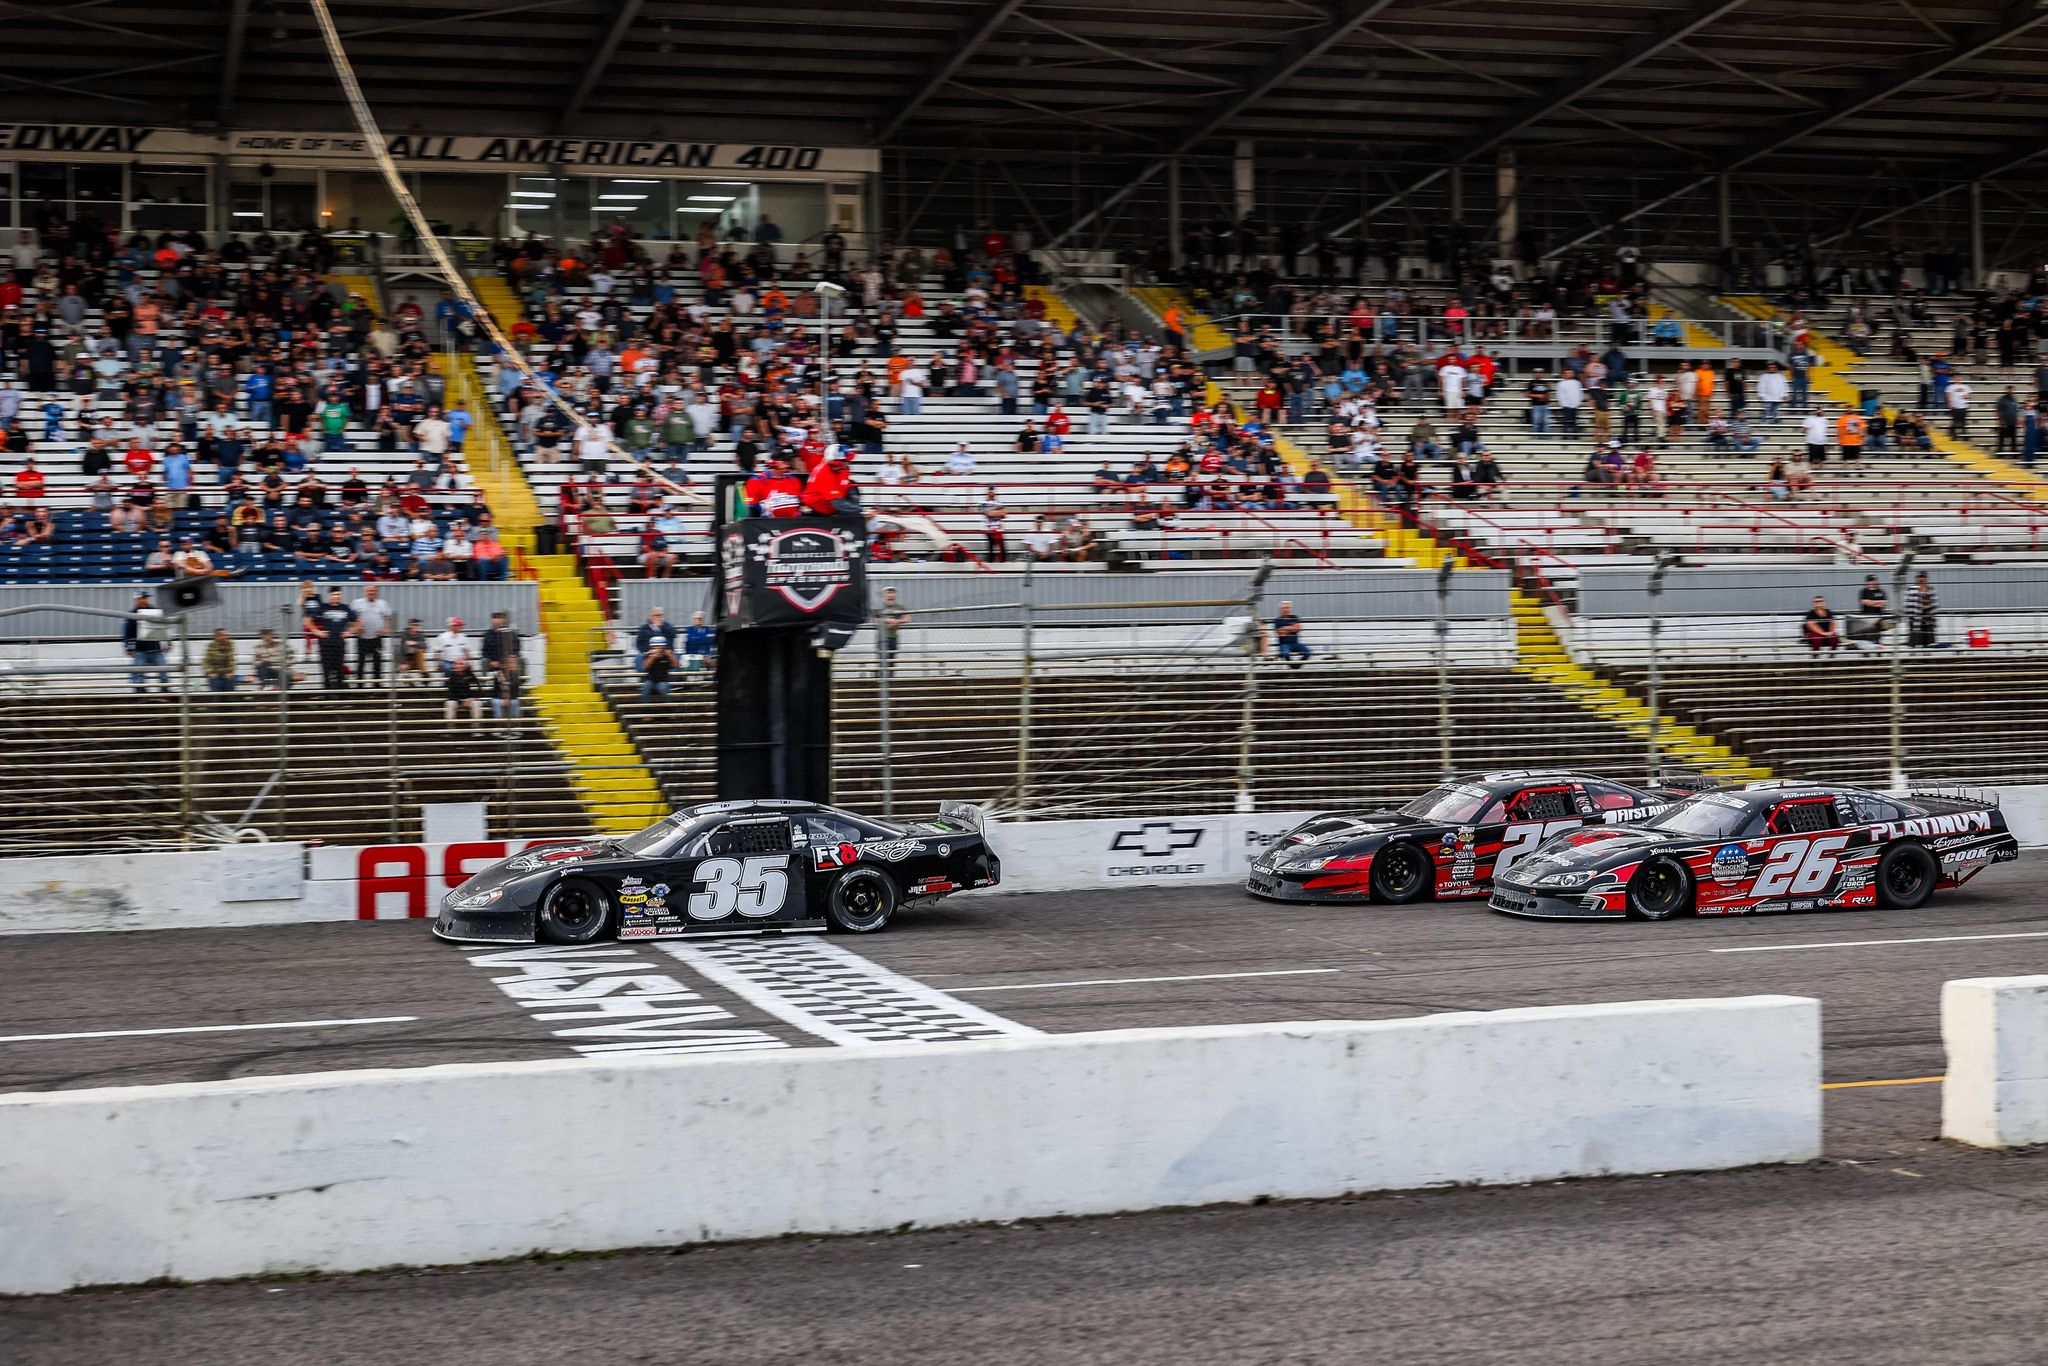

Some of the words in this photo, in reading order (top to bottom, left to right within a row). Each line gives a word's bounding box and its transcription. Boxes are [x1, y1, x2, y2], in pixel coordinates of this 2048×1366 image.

[236, 137, 294, 150] HOME
[300, 138, 325, 150] OF
[330, 139, 366, 151] THE
[388, 135, 461, 160] ALL
[478, 138, 718, 168] AMERICAN
[735, 146, 824, 170] 400
[1245, 830, 1288, 846] Per
[1869, 811, 1991, 842] PLATINUM
[815, 842, 858, 866] FR8
[856, 840, 927, 862] Racing
[1944, 847, 1990, 865] COOK
[1107, 864, 1206, 876] CHEVROLET
[1253, 864, 1274, 875] CAMRY
[1748, 835, 1850, 898] 26
[687, 854, 790, 920] 35
